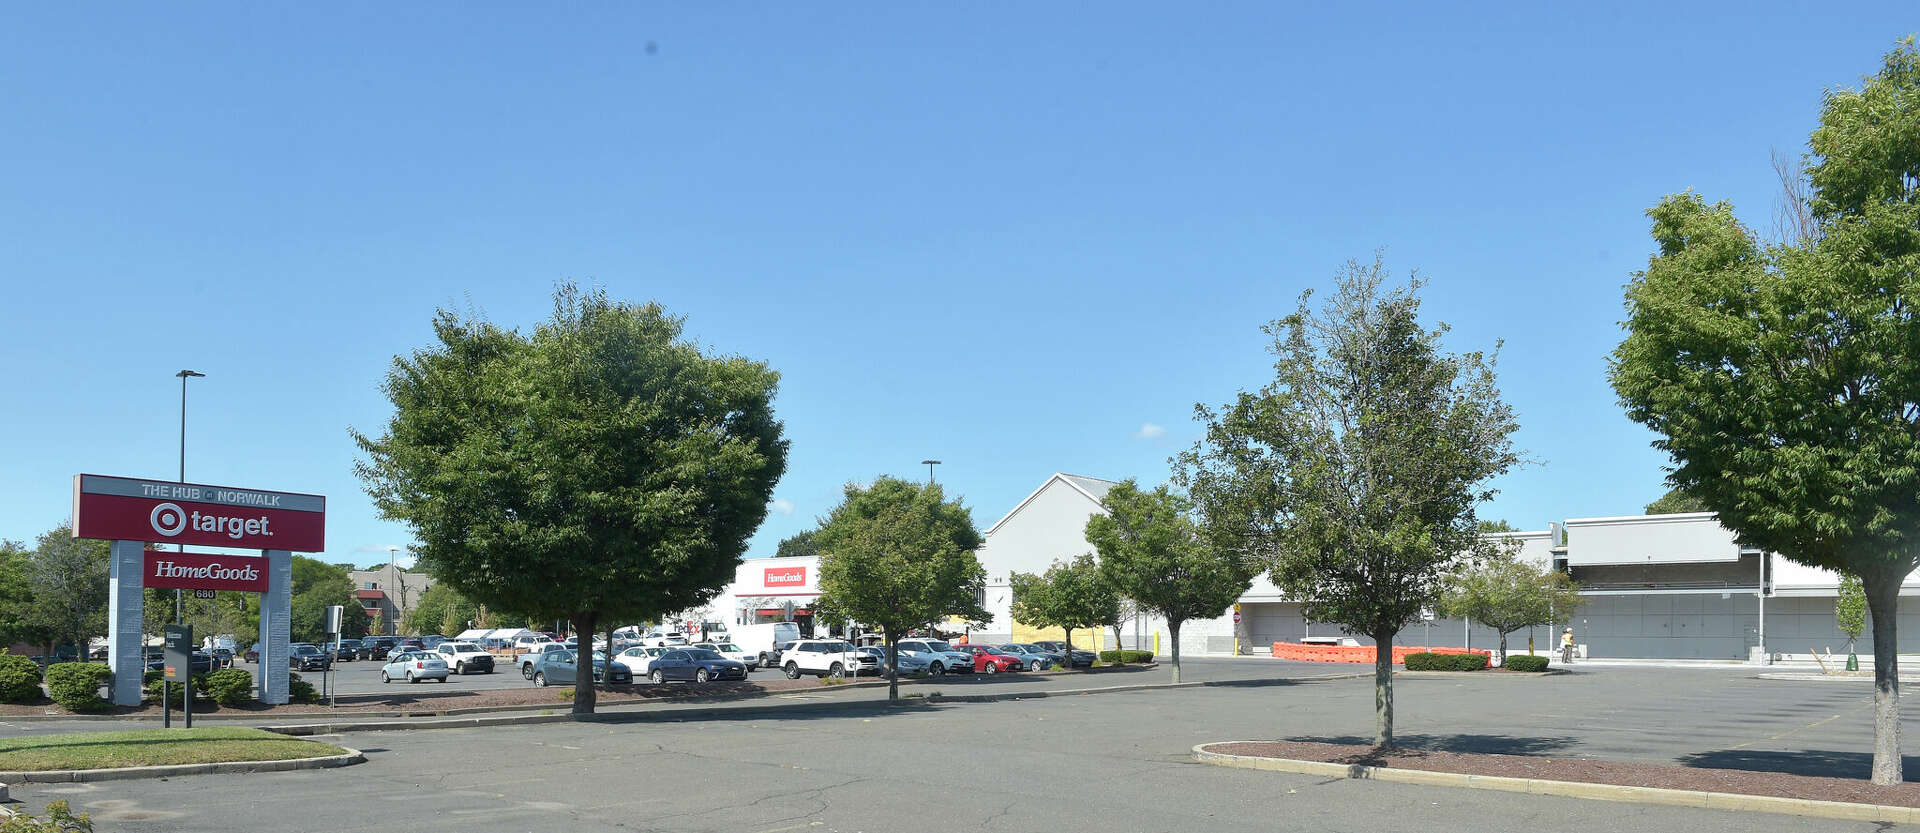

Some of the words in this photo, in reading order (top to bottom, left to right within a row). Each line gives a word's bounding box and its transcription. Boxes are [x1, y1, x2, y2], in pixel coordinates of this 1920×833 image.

[142, 484, 169, 497] THE
[172, 486, 200, 499] HUB
[217, 490, 280, 506] NORWALK
[191, 511, 274, 539] target.
[155, 561, 260, 581] HomeGoods
[767, 572, 802, 583] HomeGoods
[196, 589, 214, 598] 680
[674, 620, 700, 634] FedEx
